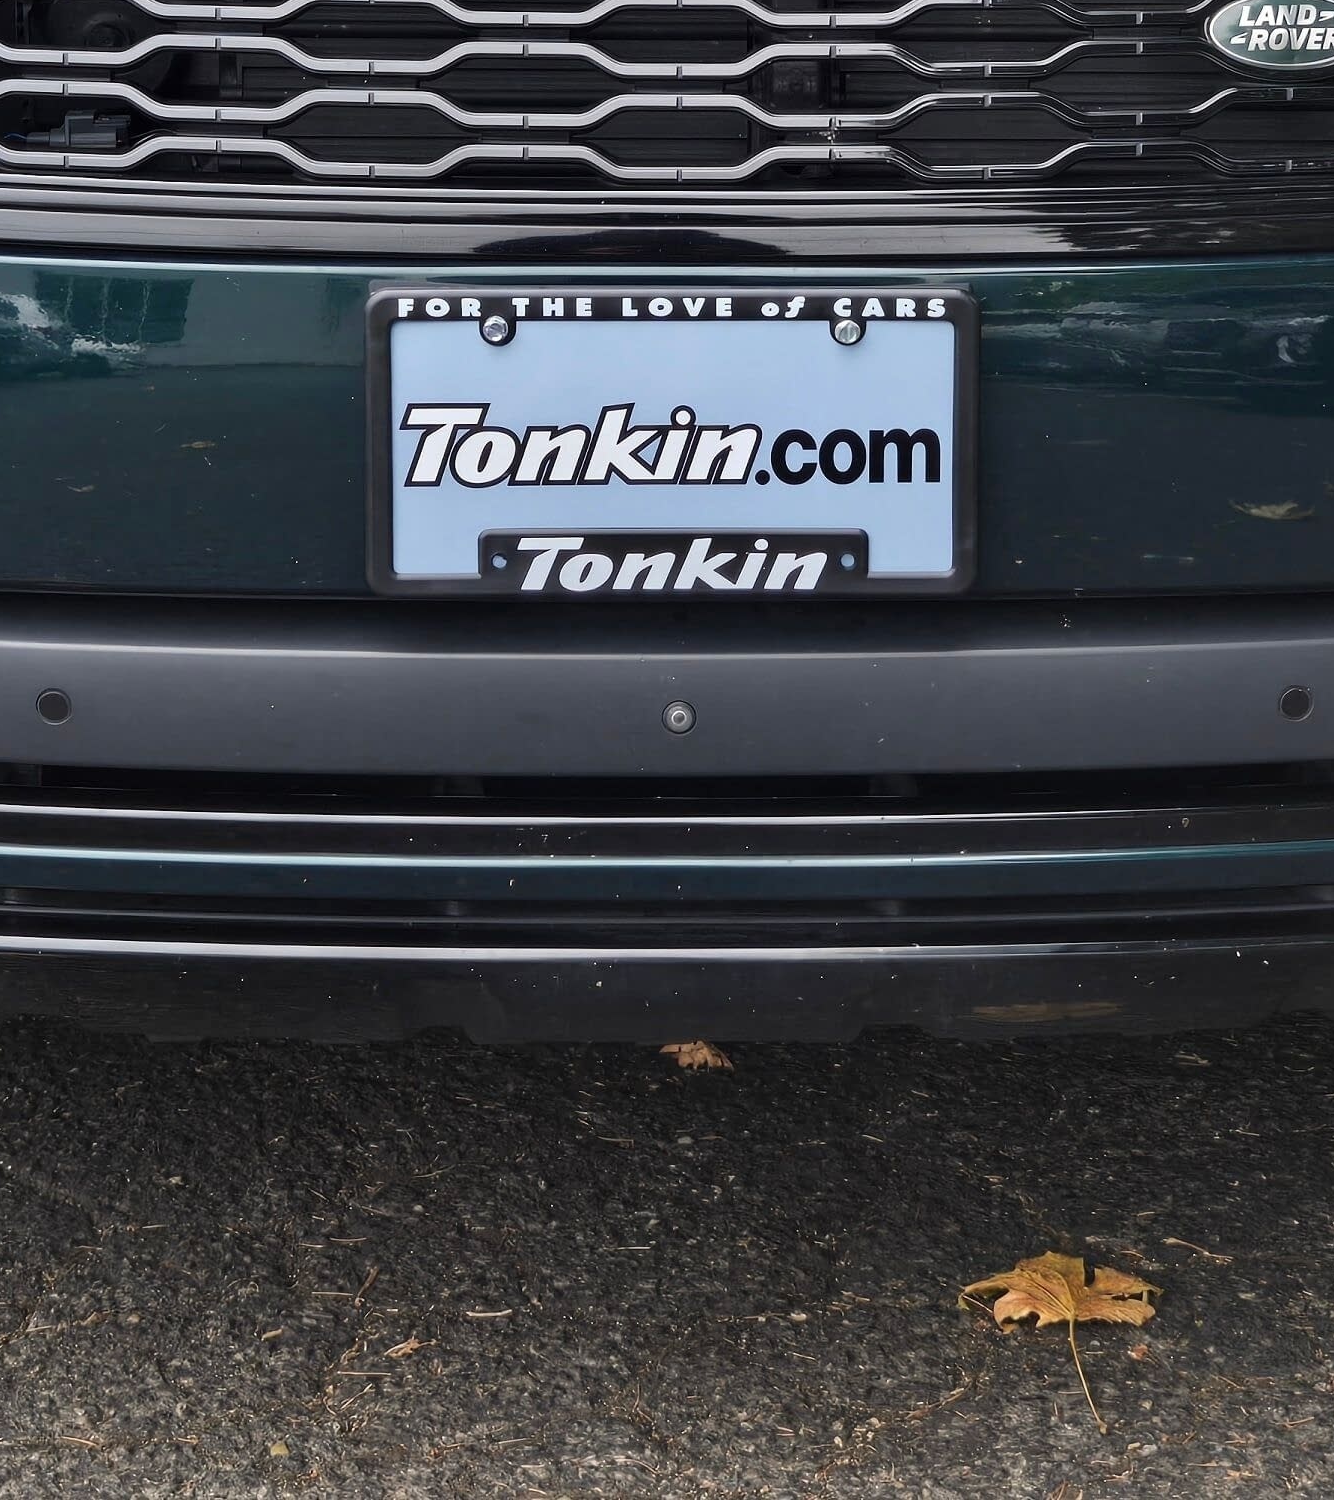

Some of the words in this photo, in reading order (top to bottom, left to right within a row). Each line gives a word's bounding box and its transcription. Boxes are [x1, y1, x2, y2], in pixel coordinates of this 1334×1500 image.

[1238, 4, 1318, 27] LAND
[398, 298, 483, 318] FOR
[512, 298, 594, 317] THE
[622, 298, 733, 317] LOVE
[761, 295, 806, 318] of
[833, 297, 947, 318] CARS
[399, 402, 942, 488] Tonkin.com
[517, 536, 828, 592] Tonkin
